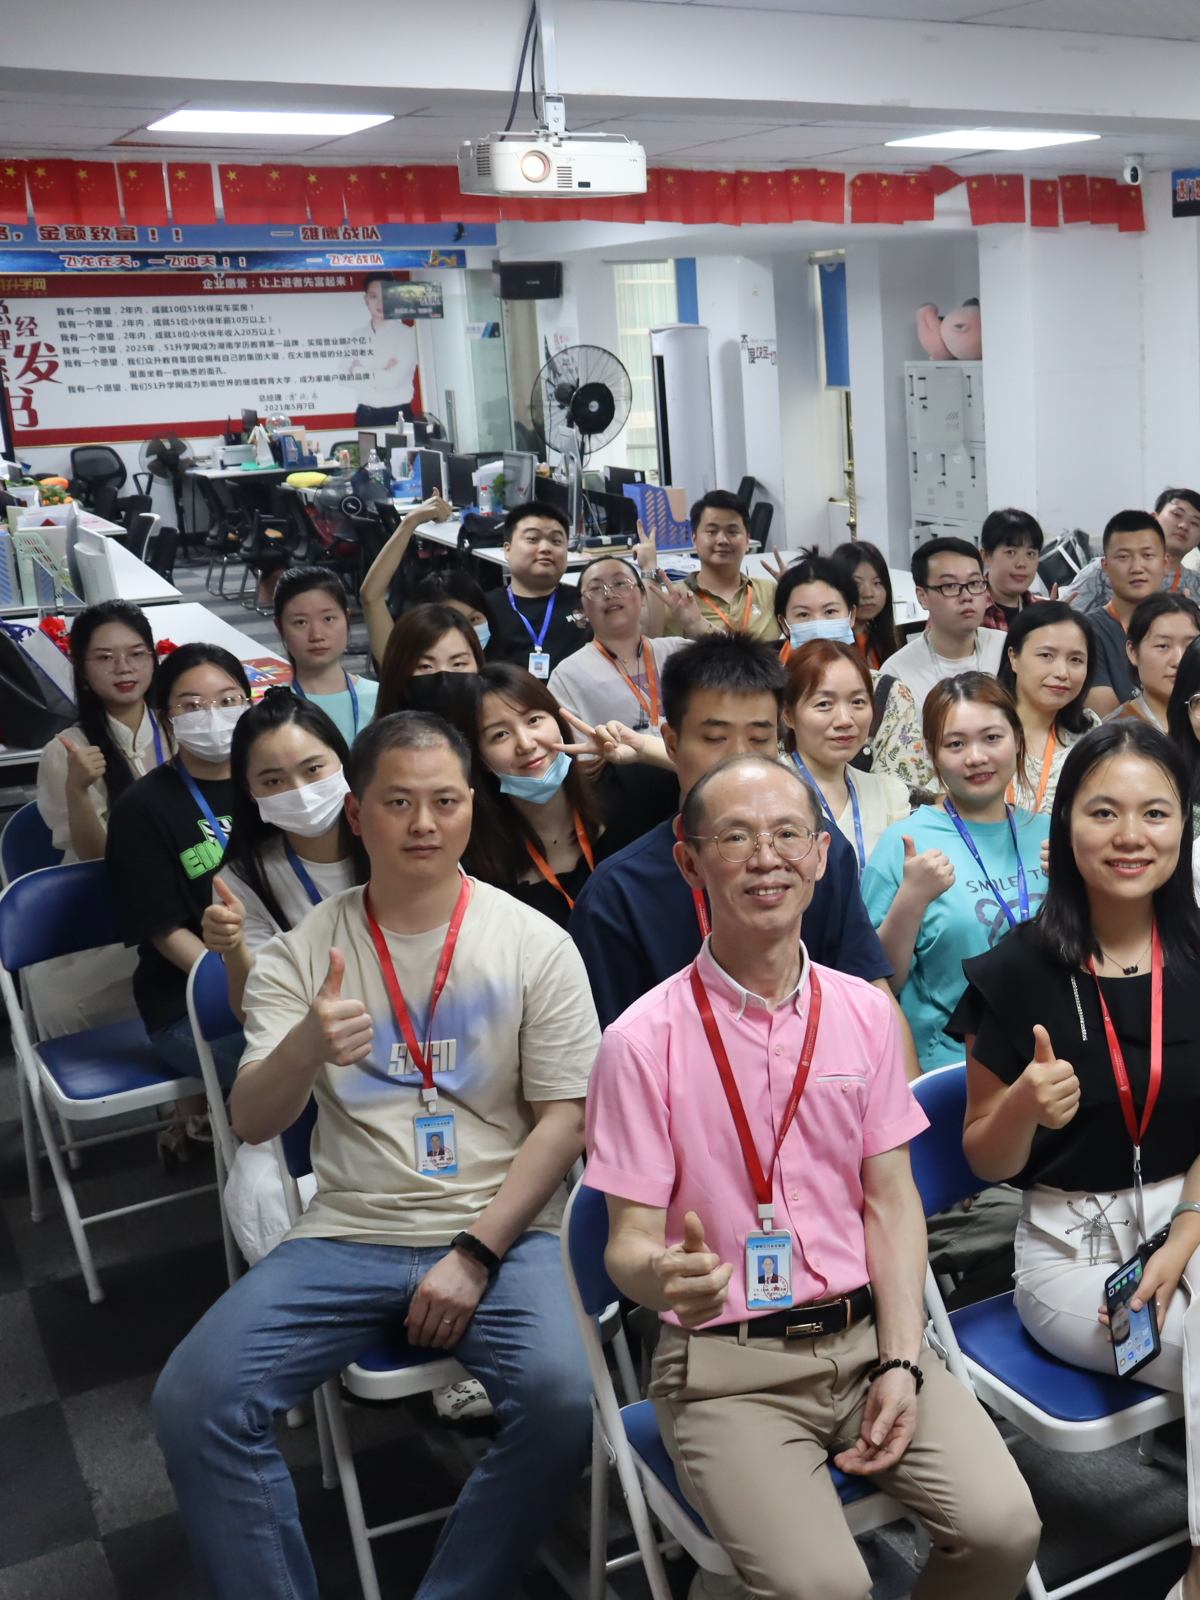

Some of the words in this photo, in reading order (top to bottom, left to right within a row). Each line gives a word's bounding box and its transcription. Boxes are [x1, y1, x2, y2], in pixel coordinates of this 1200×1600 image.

[60, 255, 248, 269] 飞龙在天，一飞冲天！！
[202, 276, 354, 290] 企业愿景：让上进者先富起来！
